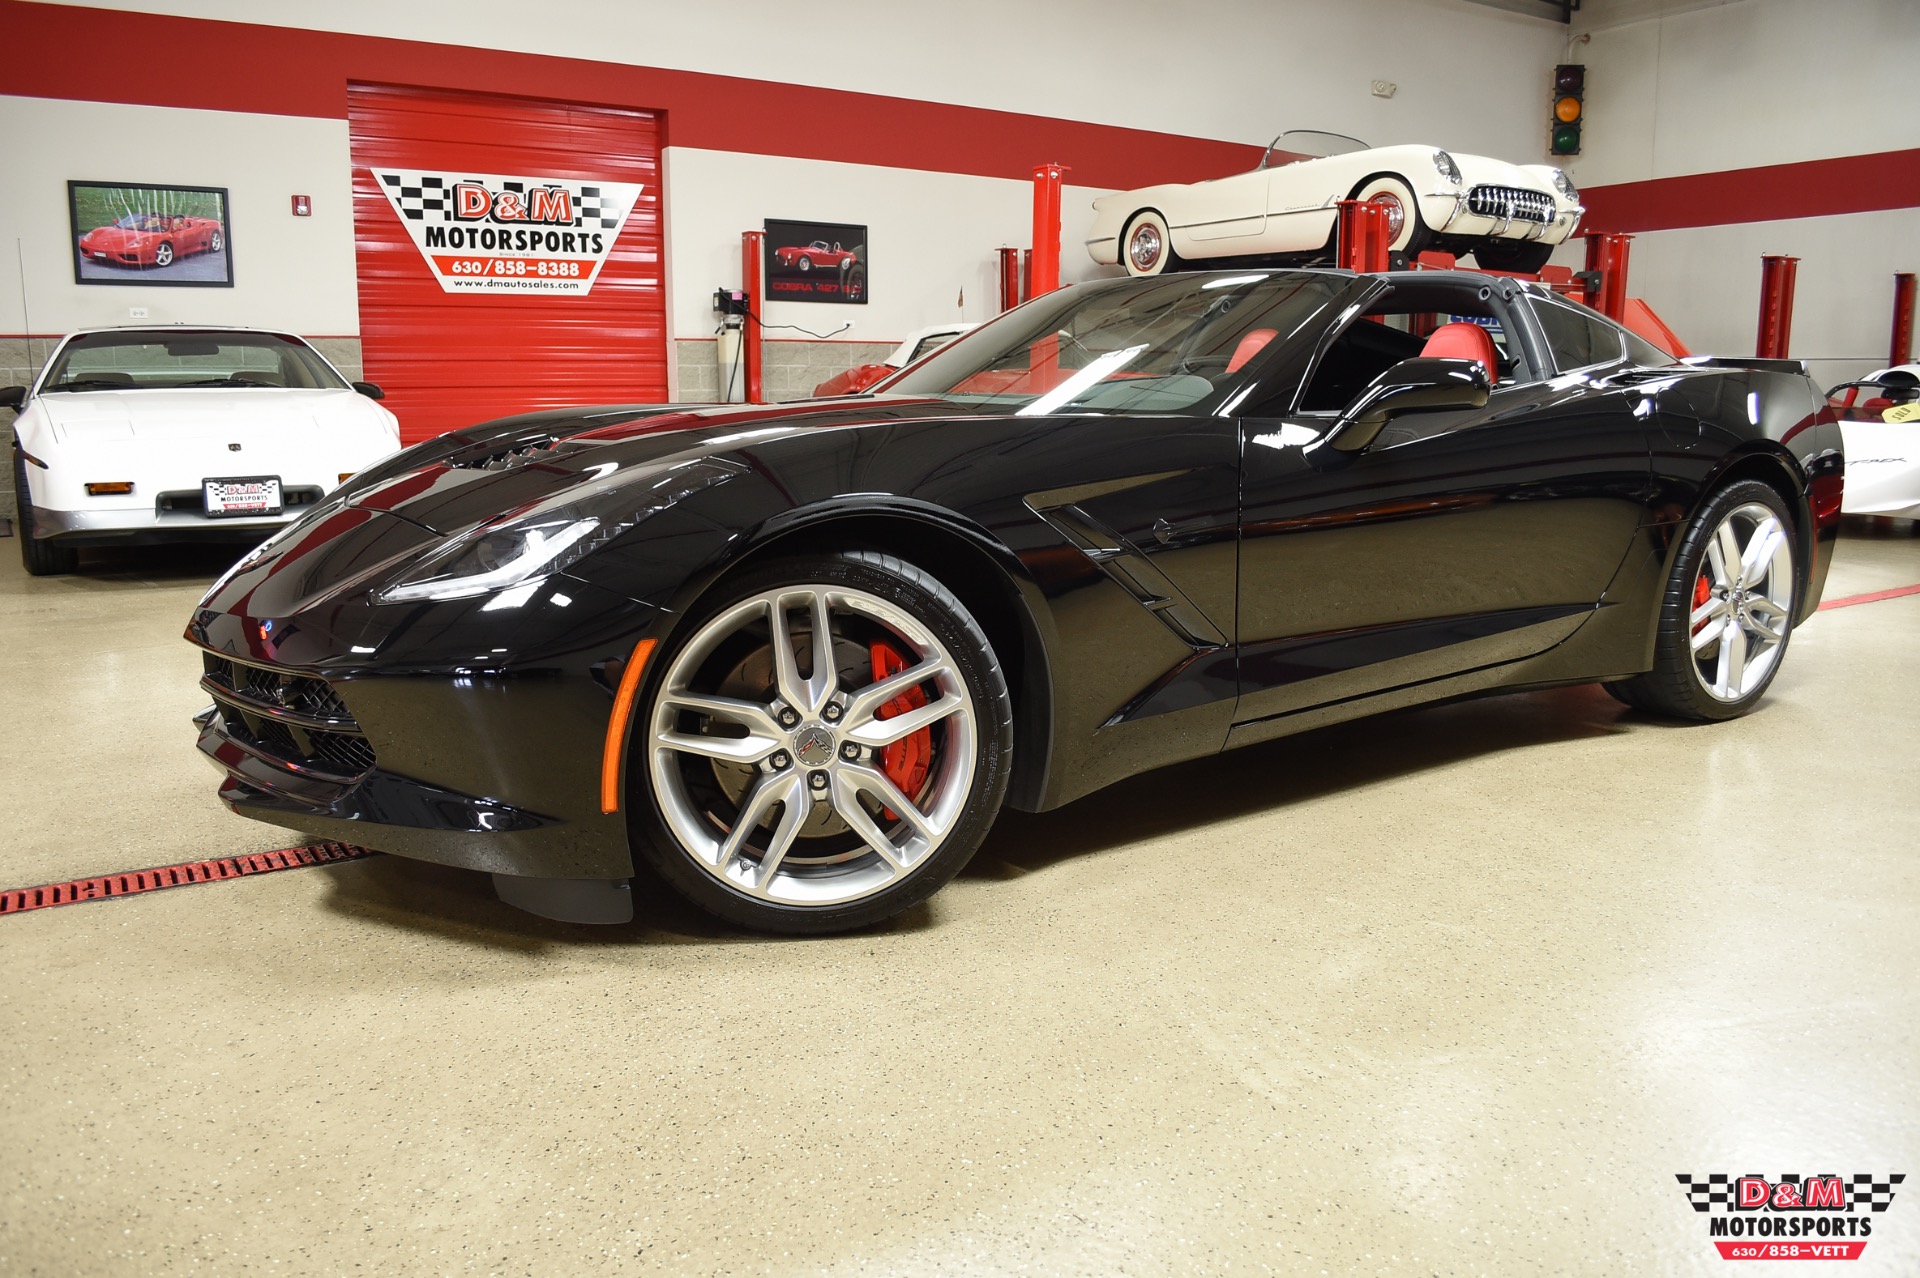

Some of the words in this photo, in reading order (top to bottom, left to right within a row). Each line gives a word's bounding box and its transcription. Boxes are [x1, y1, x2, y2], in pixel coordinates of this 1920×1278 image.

[453, 184, 573, 226] D&M
[425, 226, 604, 254] MOTORSPORTS
[451, 260, 580, 276] 630/858-8388
[453, 279, 579, 290] www.dmautosales.com
[772, 282, 813, 292] COBRA
[1891, 407, 1911, 420] SOLD
[227, 484, 260, 495] D&M
